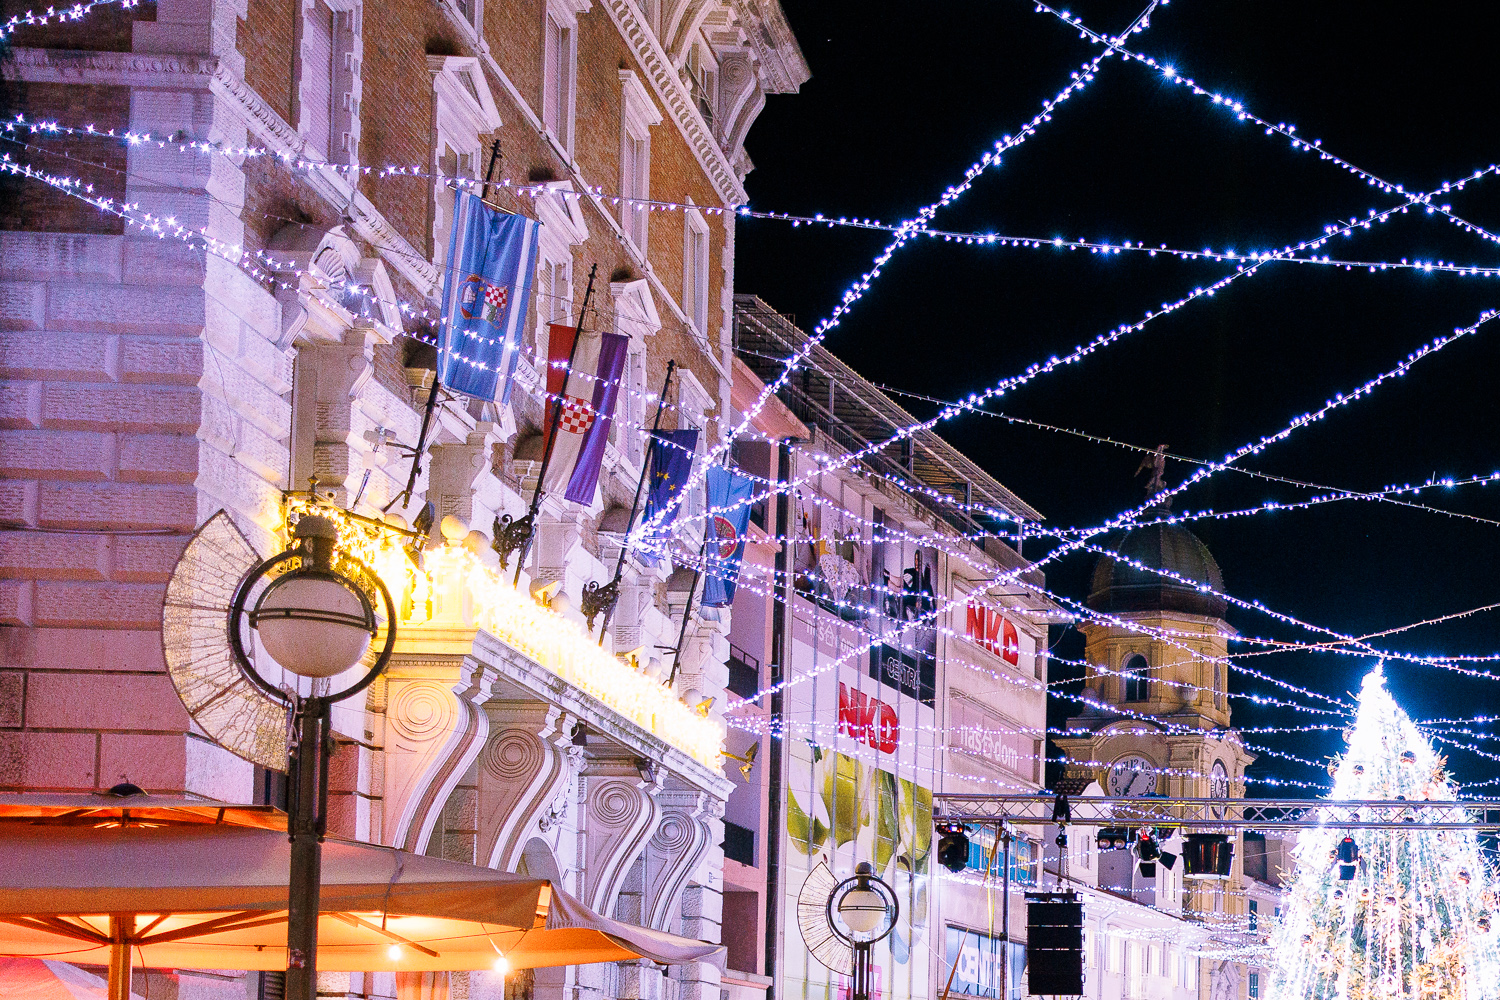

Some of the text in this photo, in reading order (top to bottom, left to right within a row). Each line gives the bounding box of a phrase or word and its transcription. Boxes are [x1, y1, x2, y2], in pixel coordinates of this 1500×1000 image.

[966, 594, 1019, 667] NKD
[839, 681, 898, 754] NKD
[994, 731, 1018, 770] dom
